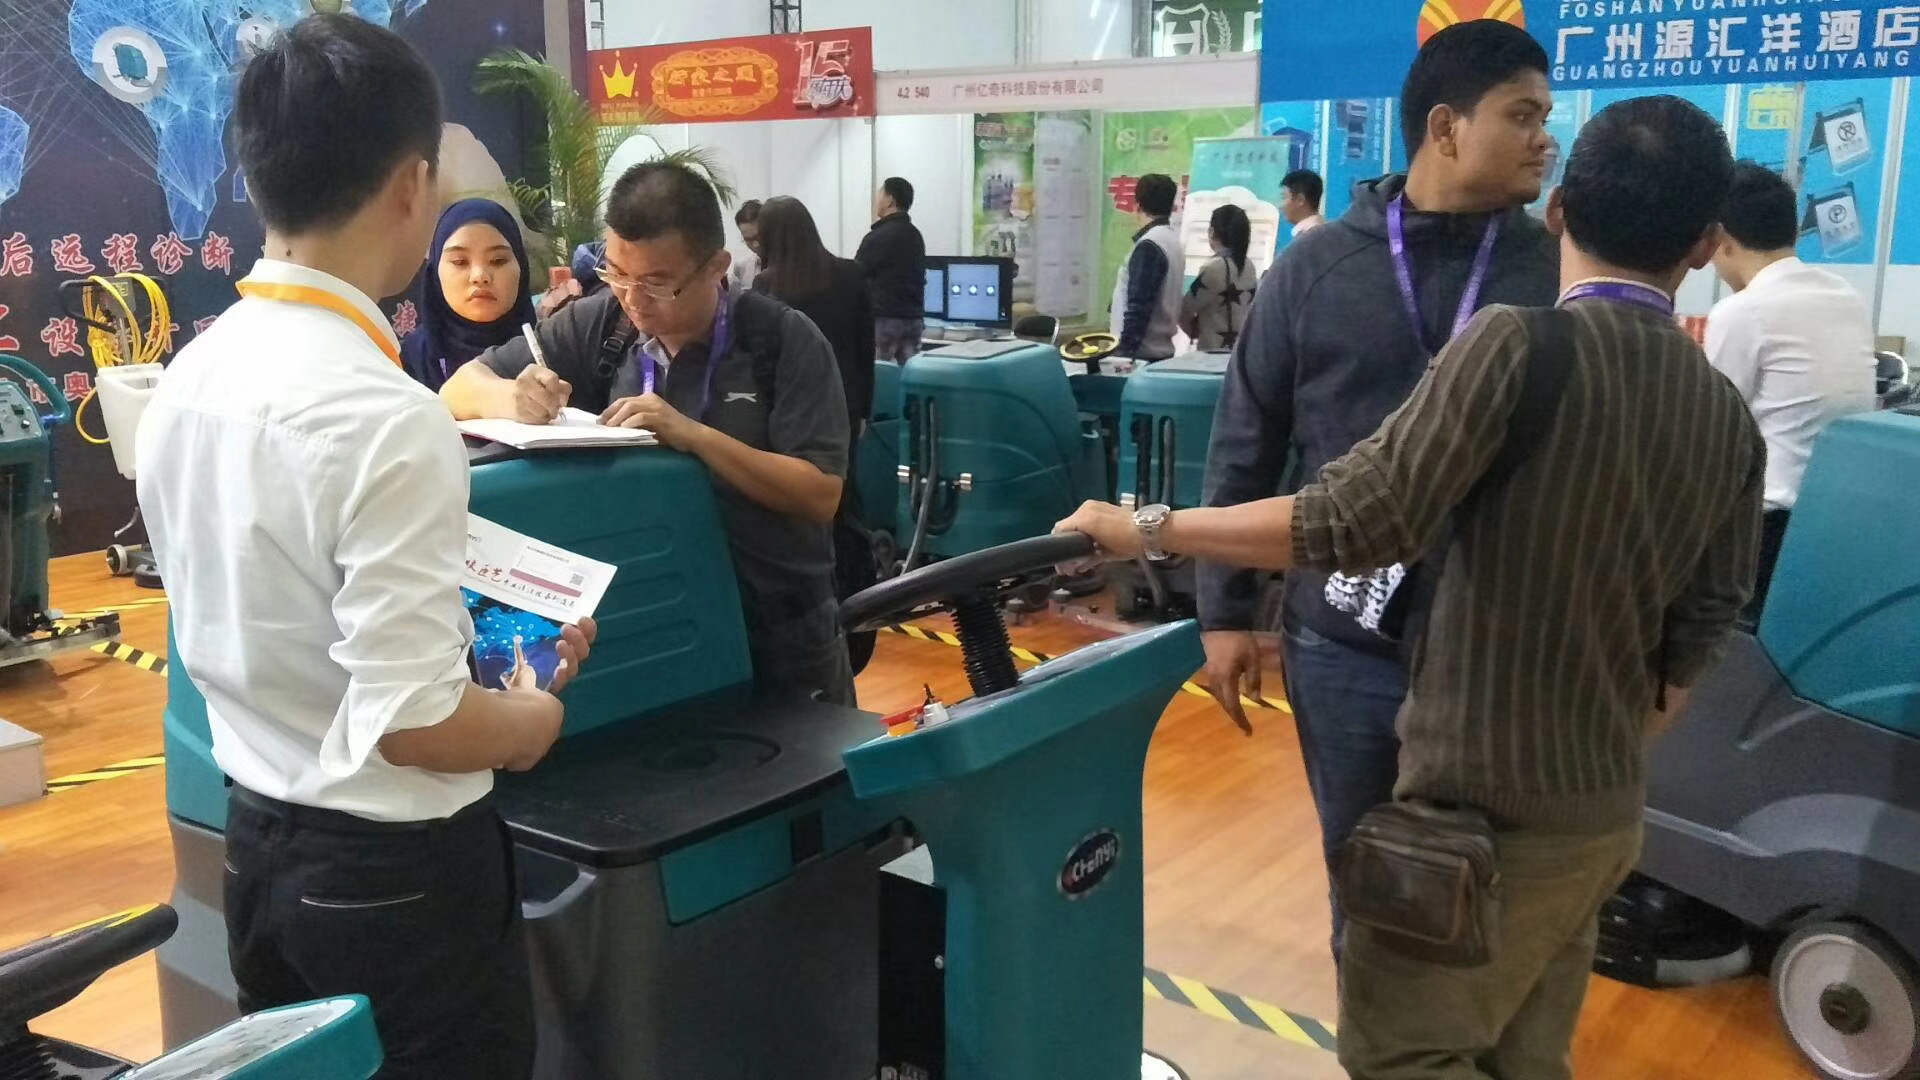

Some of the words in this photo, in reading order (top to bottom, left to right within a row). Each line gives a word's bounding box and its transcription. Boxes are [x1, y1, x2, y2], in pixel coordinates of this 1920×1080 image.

[1559, 0, 1663, 19] FOSHAN
[1555, 6, 1920, 64] 广州源汇洋酒店
[1552, 60, 1702, 81] GUANGZHOU
[1711, 50, 1909, 75] YUANHUIYANG
